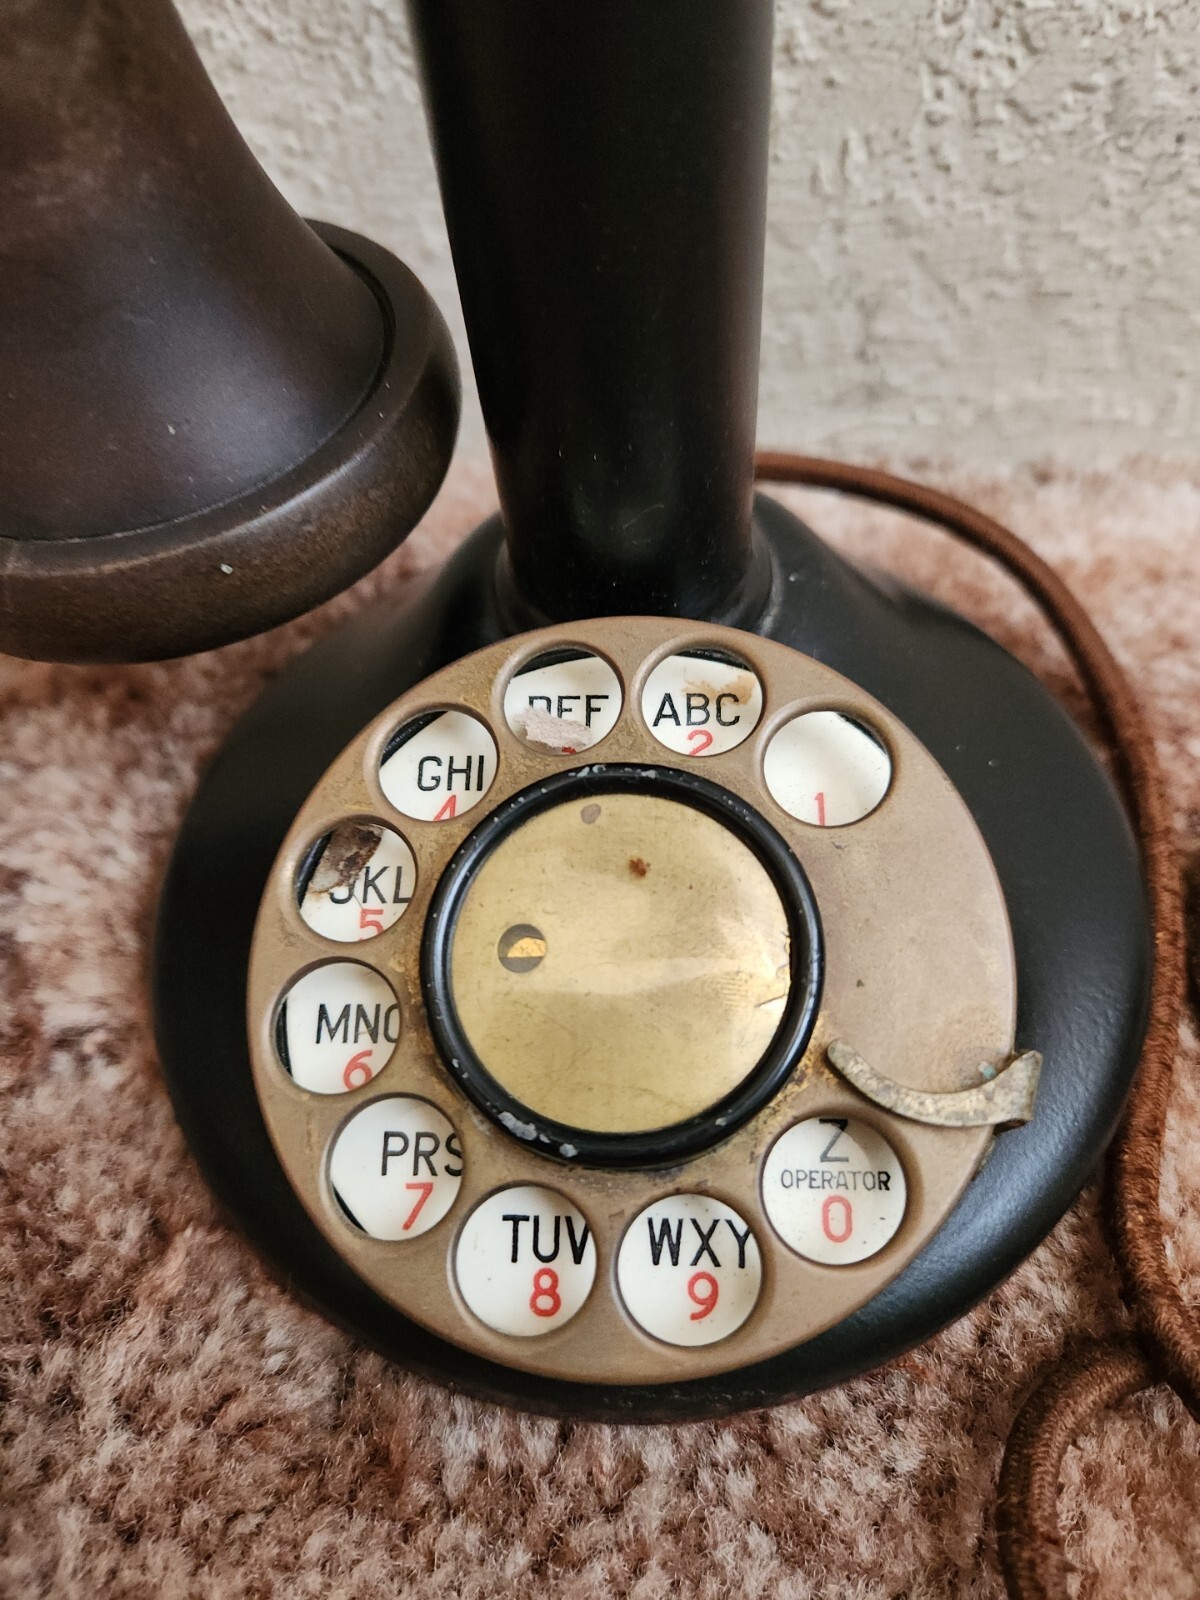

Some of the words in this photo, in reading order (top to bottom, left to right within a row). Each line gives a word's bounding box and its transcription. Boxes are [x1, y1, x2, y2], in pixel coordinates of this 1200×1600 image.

[652, 692, 741, 727] ABC
[686, 729, 714, 756] 2
[416, 754, 485, 792] GHI
[432, 794, 458, 822] 4
[813, 791, 826, 827] 1
[357, 908, 385, 941] 5
[342, 1049, 374, 1092] 6
[380, 1130, 463, 1178] PRS
[818, 1118, 850, 1163] Z
[780, 1168, 892, 1191] OPERATOR
[401, 1182, 435, 1231] 7
[821, 1194, 854, 1244] 0
[501, 1213, 591, 1265] TUV
[647, 1216, 753, 1270] WXY
[528, 1267, 562, 1318] 8
[687, 1271, 720, 1321] 9
